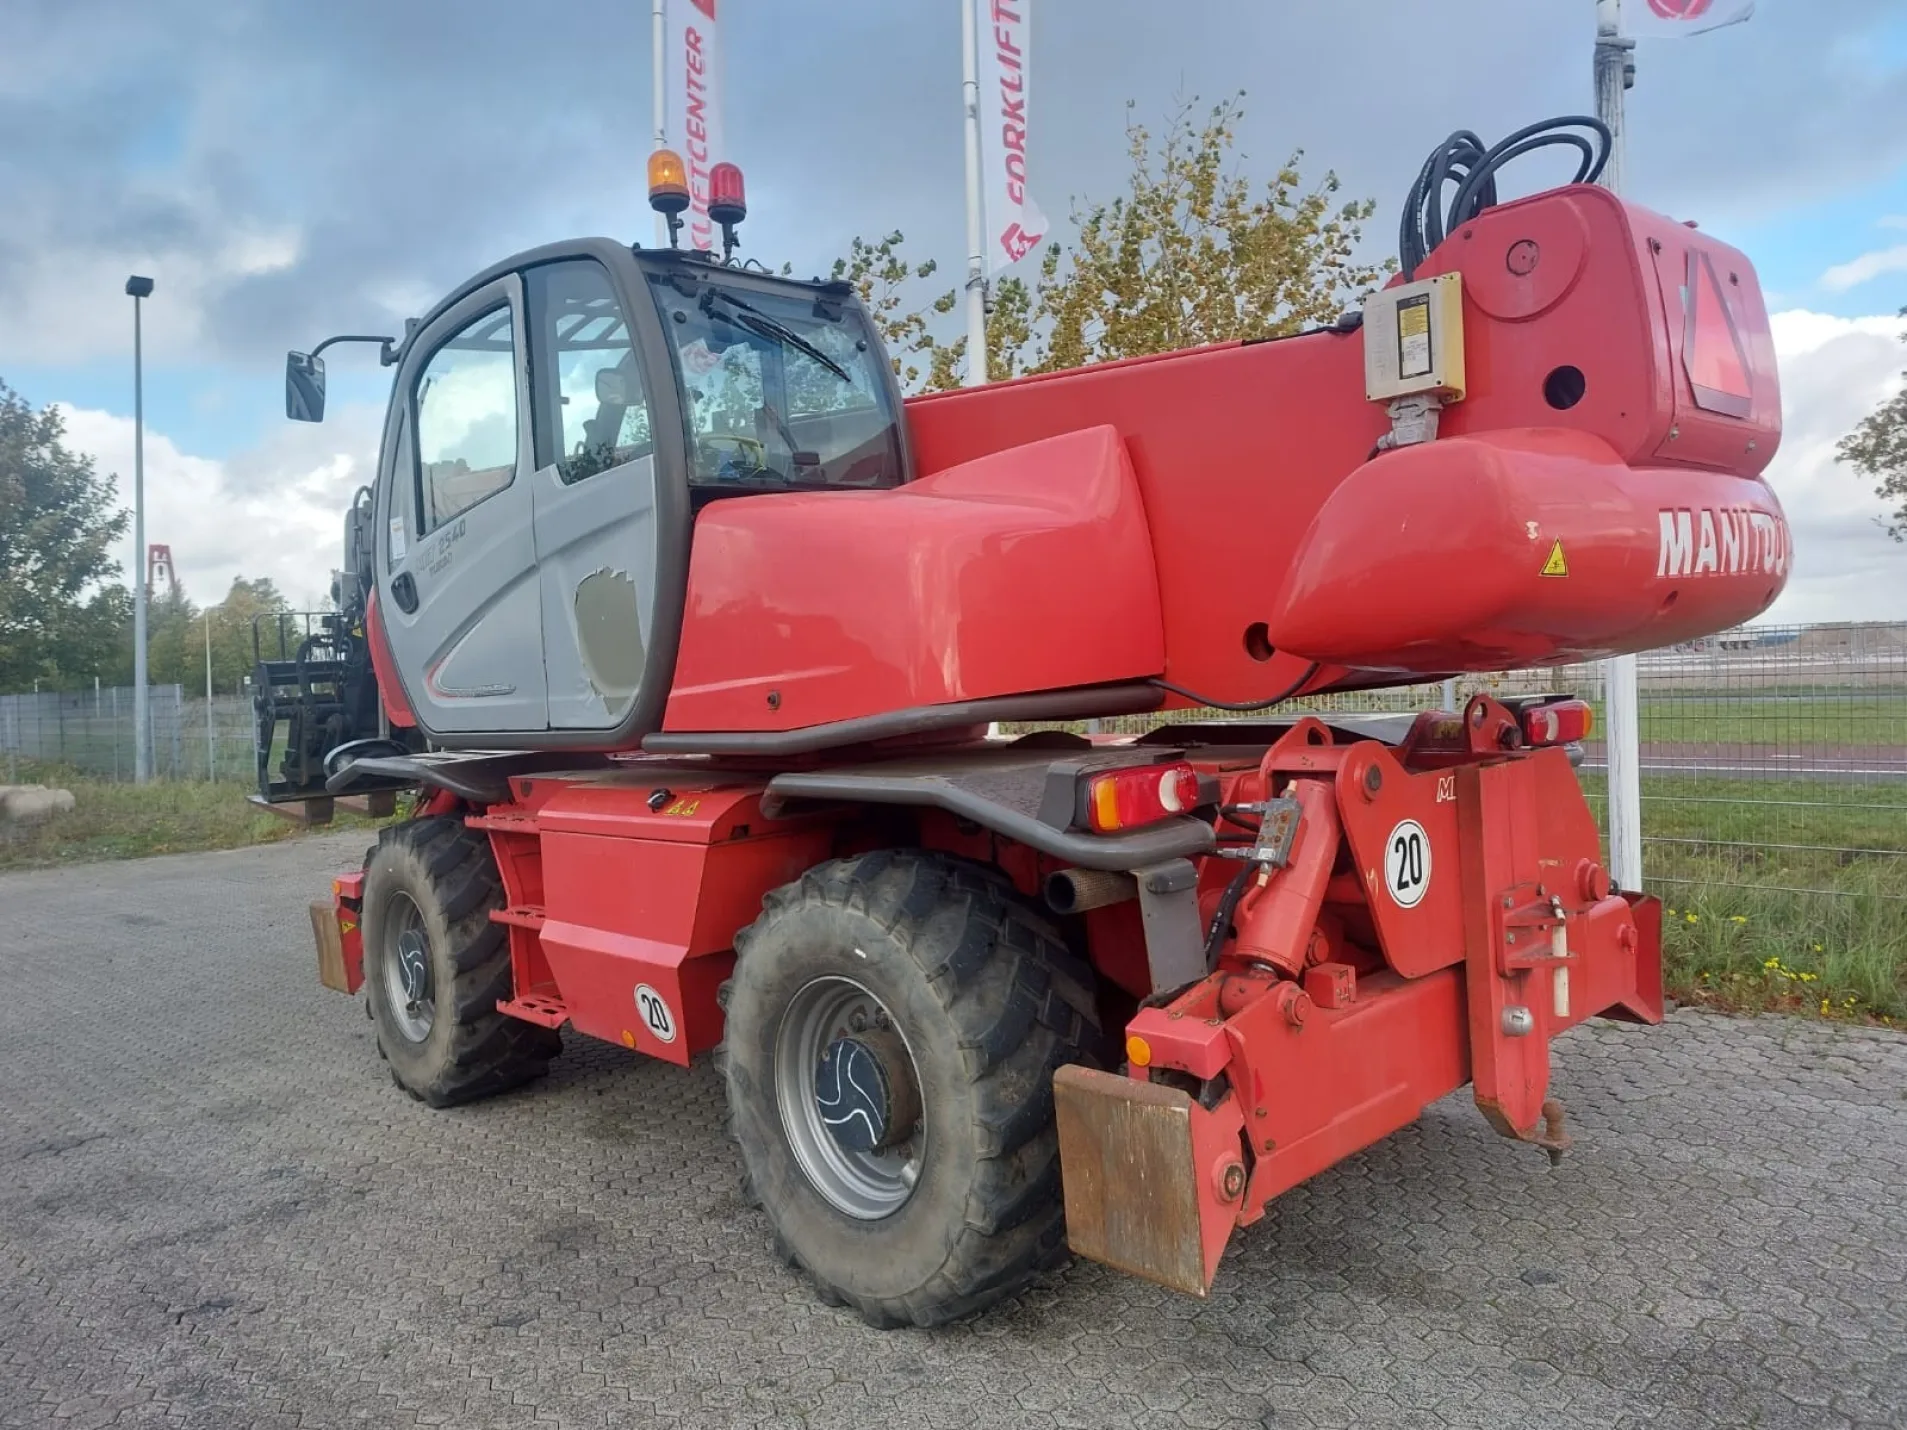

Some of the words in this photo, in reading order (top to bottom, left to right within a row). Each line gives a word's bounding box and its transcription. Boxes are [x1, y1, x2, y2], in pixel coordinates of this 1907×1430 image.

[438, 518, 466, 555] 2540
[1656, 510, 1786, 577] MANITOU
[1394, 833, 1422, 890] 20
[641, 993, 670, 1033] 20
